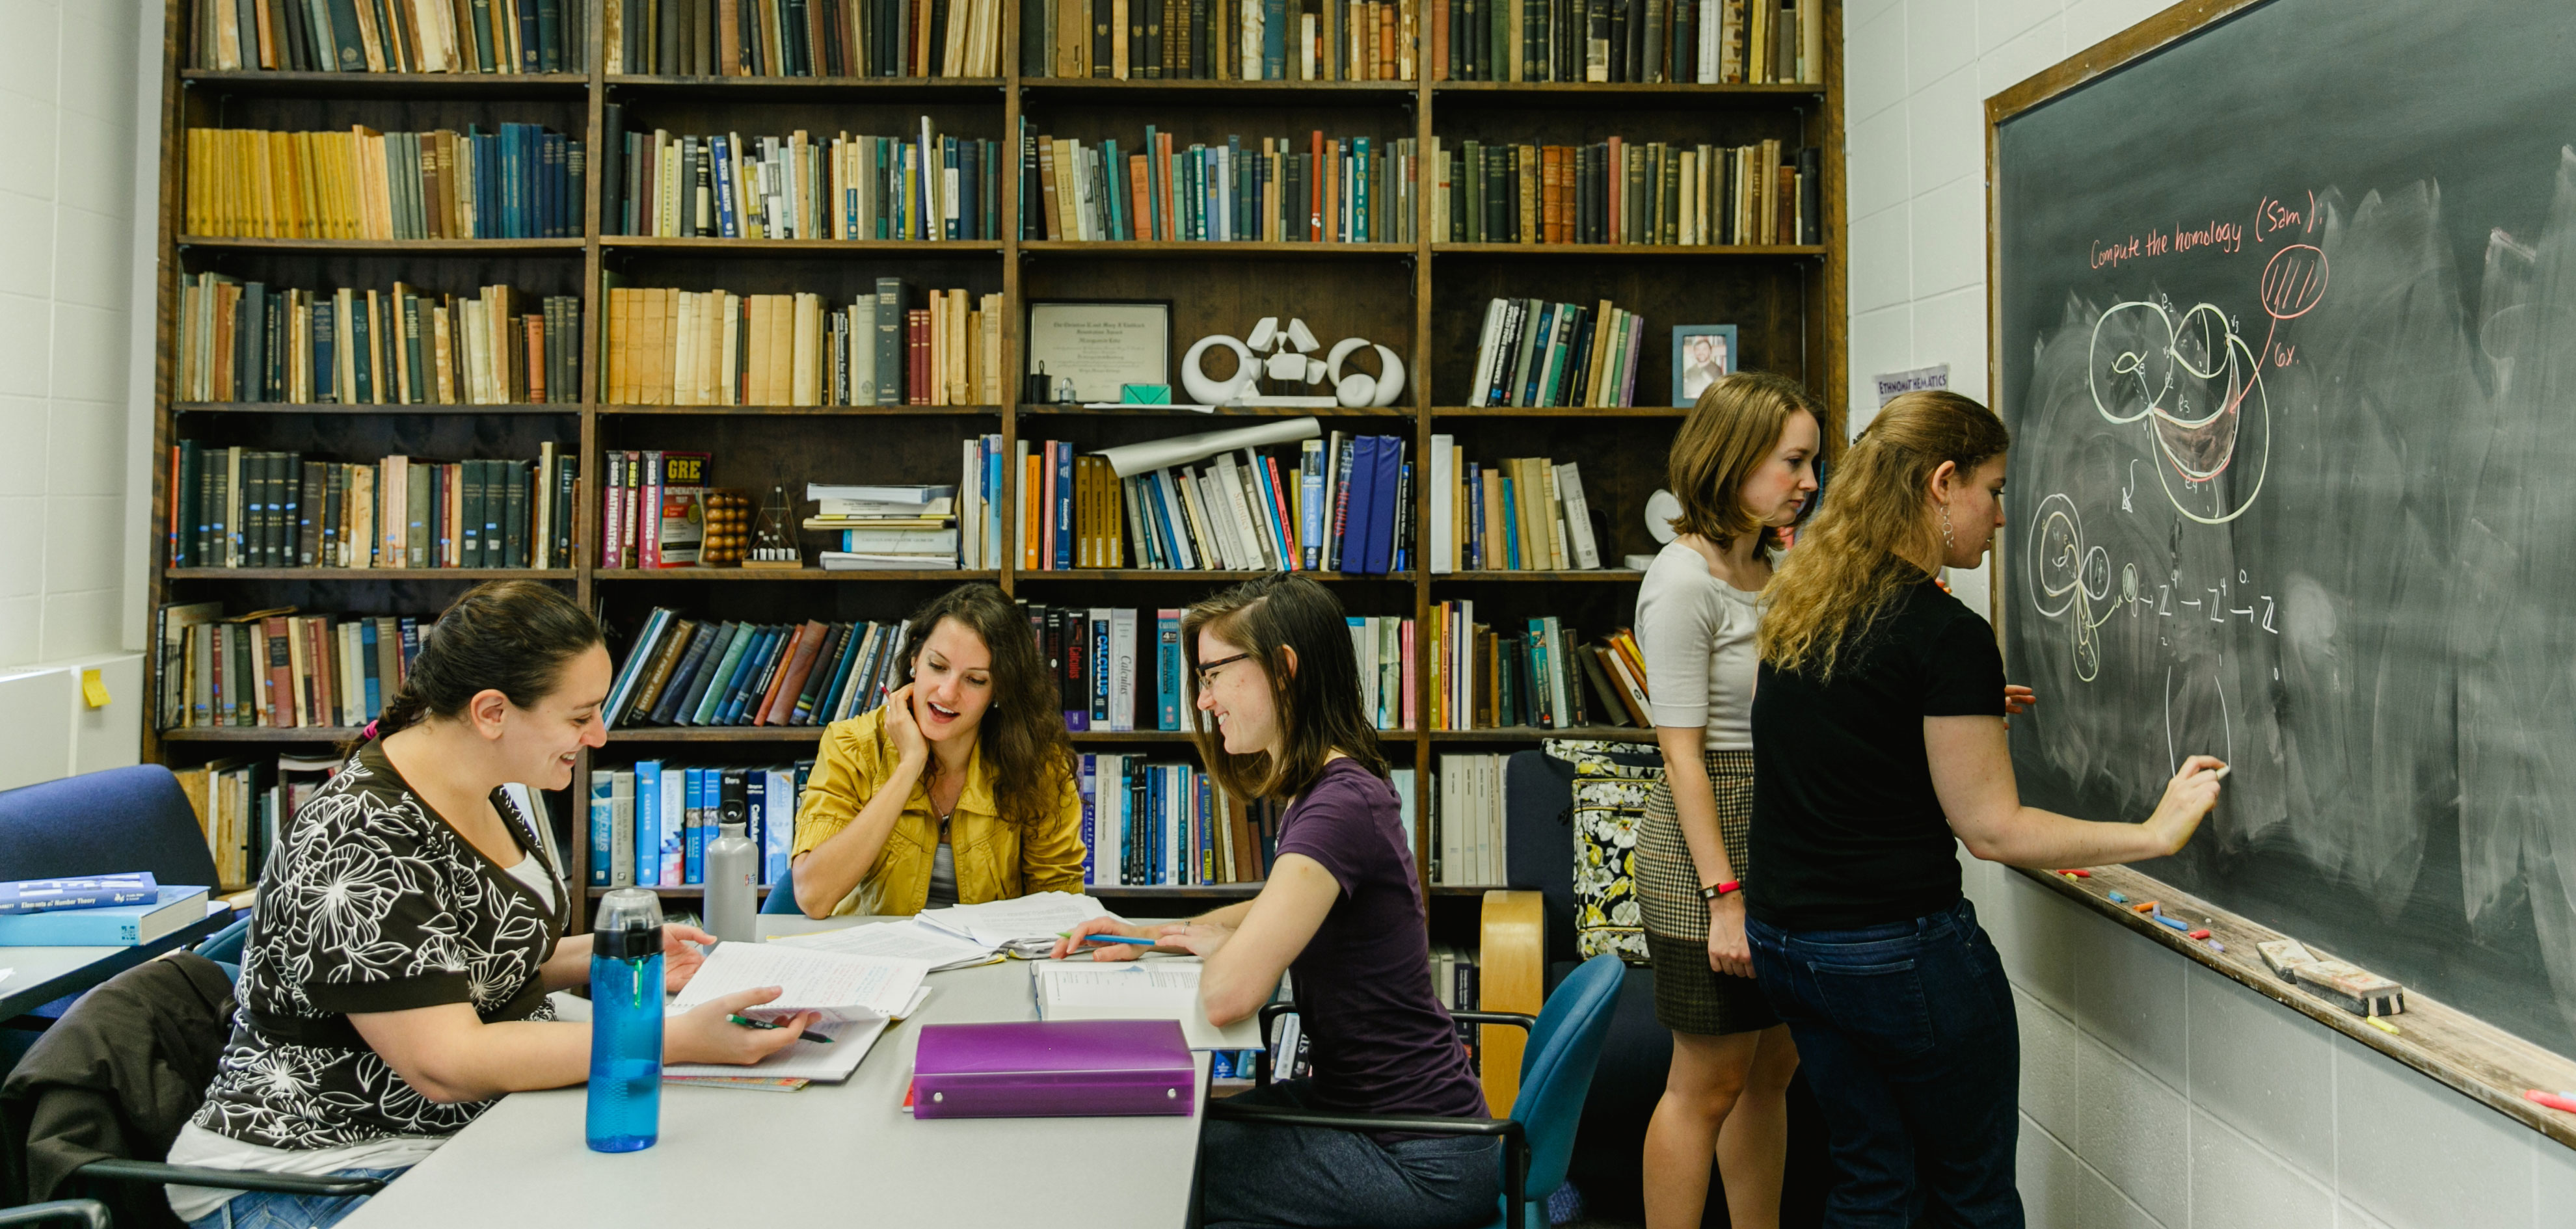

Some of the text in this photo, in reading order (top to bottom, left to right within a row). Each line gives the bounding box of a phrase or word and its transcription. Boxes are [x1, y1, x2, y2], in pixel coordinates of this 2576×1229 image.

[719, 158, 731, 212] VECTOR ANALYSIS
[2091, 235, 2140, 269] Compute
[2146, 228, 2169, 256] the
[2175, 220, 2242, 252] homology
[628, 462, 637, 487] GRE
[647, 460, 656, 485] GRE
[667, 459, 702, 479] GRE
[607, 488, 618, 553] MATHEMATICS
[625, 490, 636, 546] MATHEMATICS
[645, 486, 656, 540] MATHEMATICS
[1061, 497, 1069, 531] Accounting
[1232, 491, 1252, 531] Statistics
[1333, 481, 1350, 536] CALCULUS
[651, 657, 669, 684] FACTOR
[1069, 646, 1082, 679] Calculus
[1097, 635, 1108, 696] CALCULUS
[1120, 655, 1132, 695] Calculus
[599, 804, 610, 852] CALCULUS
[751, 804, 760, 844] Calculus
[21, 901, 46, 909] Elements
